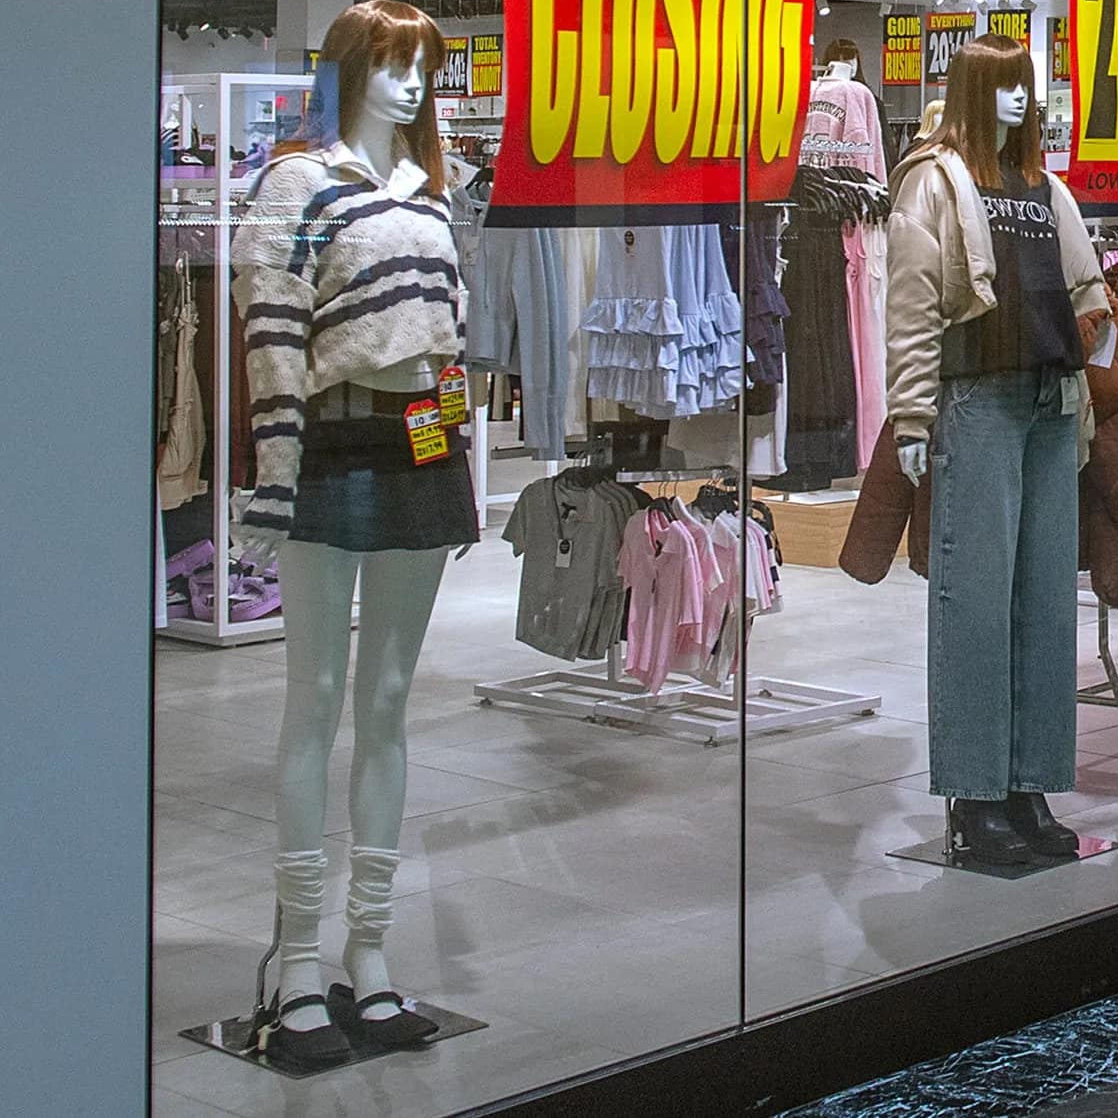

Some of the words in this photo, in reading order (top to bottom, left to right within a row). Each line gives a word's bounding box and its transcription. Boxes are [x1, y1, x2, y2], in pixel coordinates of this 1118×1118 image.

[887, 16, 921, 37] GOING
[990, 13, 1027, 40] STORE
[474, 36, 499, 51] TOTAL
[887, 37, 911, 50] OUT
[885, 50, 921, 80] BUSINESS
[1020, 229, 1053, 239] ISLAN
